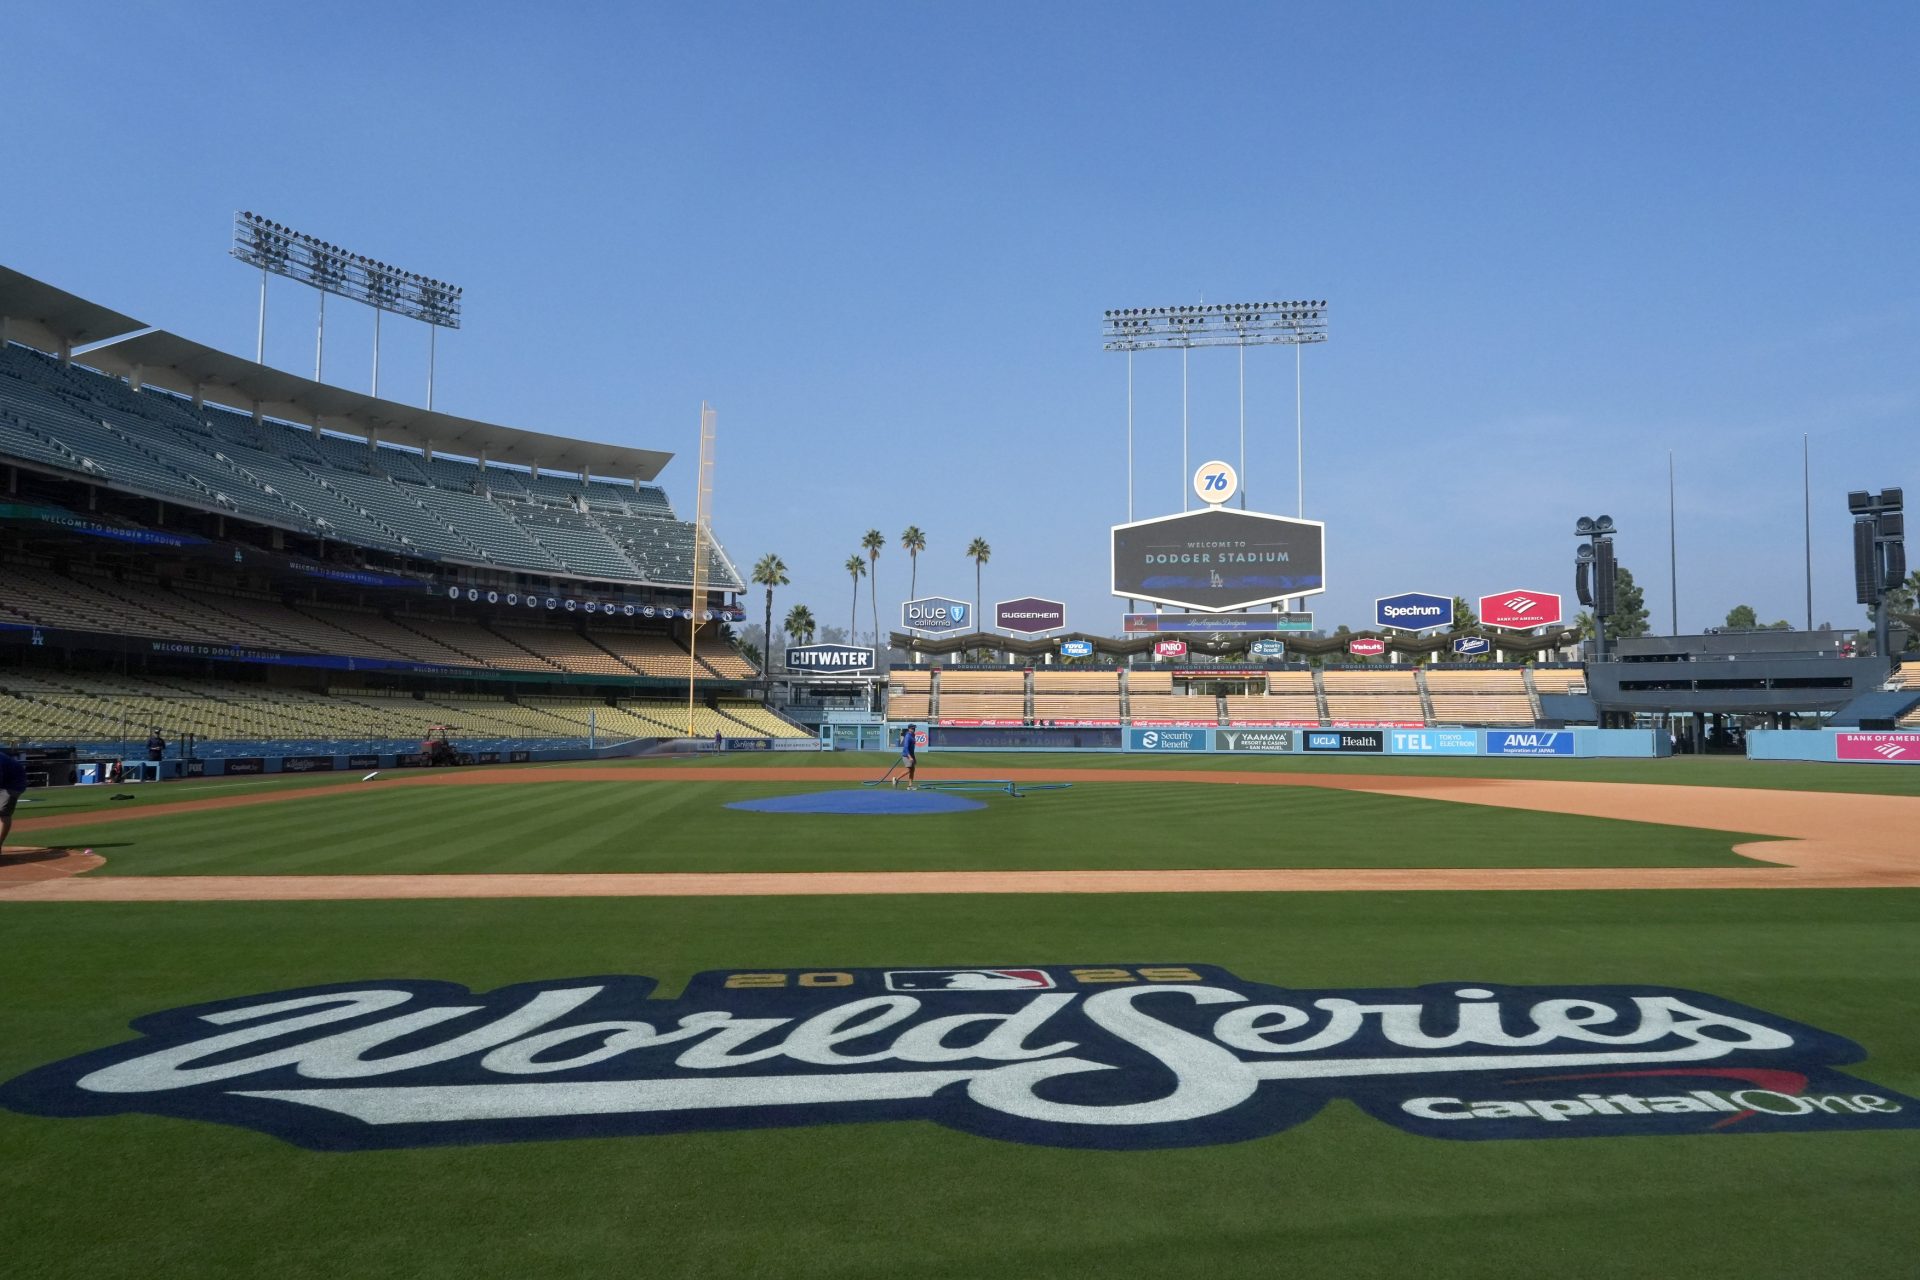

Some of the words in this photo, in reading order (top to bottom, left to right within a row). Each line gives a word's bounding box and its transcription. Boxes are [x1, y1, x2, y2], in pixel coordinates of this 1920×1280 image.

[1204, 472, 1228, 491] 76
[40, 513, 88, 529] WELCOME
[91, 522, 103, 532] TO
[105, 526, 142, 538] DODGER
[145, 533, 182, 547] STADIUM
[1187, 541, 1231, 549] WELCOME
[1234, 540, 1246, 548] TO
[1145, 553, 1211, 564] DODGER
[1218, 551, 1290, 563] STADIUM
[547, 600, 556, 608] 20
[567, 601, 576, 609] 24
[909, 604, 946, 619] blue
[1001, 611, 1059, 619] GUGGENHEIM
[1384, 605, 1440, 618] Spectrum
[152, 642, 195, 654] WELCOME
[197, 646, 209, 655] TO
[1160, 643, 1182, 653] JINRO
[791, 651, 868, 666] CUTWATER
[1161, 732, 1193, 742] Security
[1313, 737, 1336, 745] UCLA
[1342, 736, 1376, 747] Health
[1394, 734, 1432, 750] TEL
[1504, 734, 1538, 746] ANA
[1161, 740, 1189, 749] Benefit
[188, 763, 203, 772] FOX
[724, 972, 855, 989] 20
[1070, 967, 1203, 982] 25
[76, 986, 1080, 1093] World
[967, 985, 1794, 1125] Series
